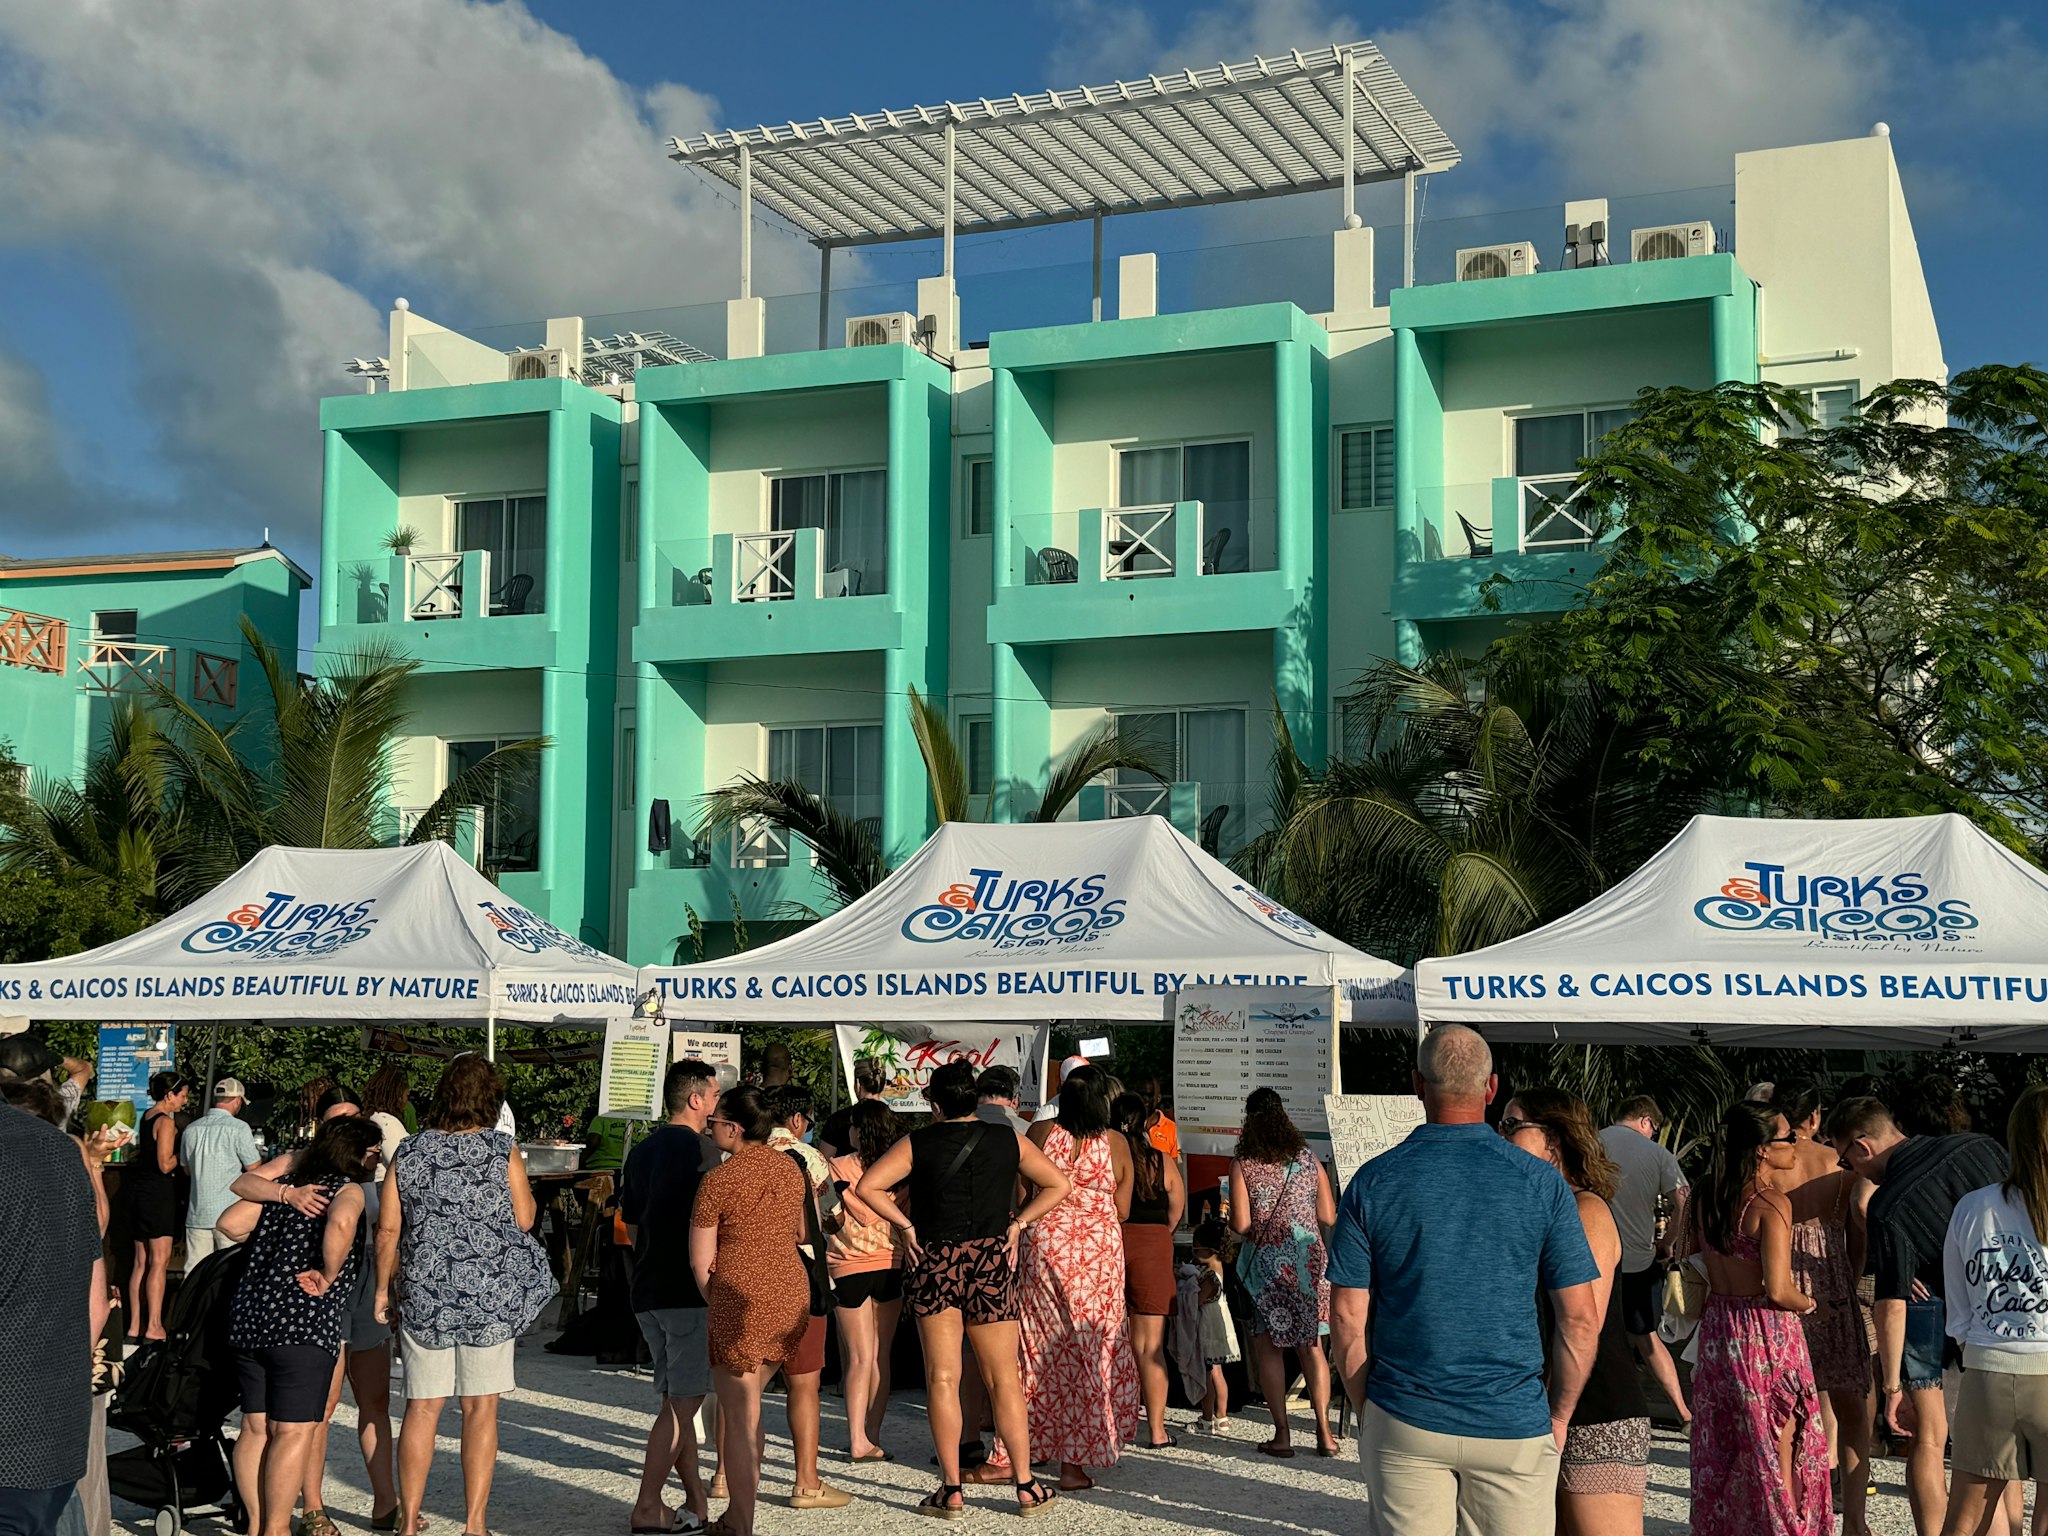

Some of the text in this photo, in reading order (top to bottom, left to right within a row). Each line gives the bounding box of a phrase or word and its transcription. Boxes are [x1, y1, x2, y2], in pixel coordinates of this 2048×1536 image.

[966, 868, 1106, 914] TURKS
[1745, 861, 1928, 909] TURKS
[246, 891, 377, 931] TURKS
[901, 900, 1127, 943] CAICOS
[1694, 896, 1979, 933] CAICOS
[181, 918, 379, 954] CAICOS
[28, 979, 43, 999] &
[50, 977, 128, 999] CAICOS
[135, 976, 225, 998] ISLANDS
[232, 975, 349, 996] BEAUTIFUL
[356, 976, 385, 997] BY
[389, 977, 480, 999] NATURE
[506, 983, 538, 1003] TURKS
[541, 983, 548, 1003] &
[550, 983, 585, 1004] CAICOS
[587, 984, 624, 1004] ISLANDS
[655, 977, 737, 999] TURKS
[745, 976, 763, 999] &
[771, 974, 868, 998] CAICOS
[877, 972, 988, 996] ISLANDS
[997, 970, 1144, 995] BEAUTIFUL
[1154, 972, 1187, 995] BY
[1442, 974, 1547, 1000] TURKS
[1558, 974, 1580, 998] &
[1590, 973, 1712, 996] CAICOS
[1724, 973, 1868, 998] ISLANDS
[1197, 1009, 1234, 1026] Kool
[688, 1039, 728, 1051] We accept
[905, 1038, 1000, 1072] Kool
[1966, 1247, 2044, 1294] Turks &
